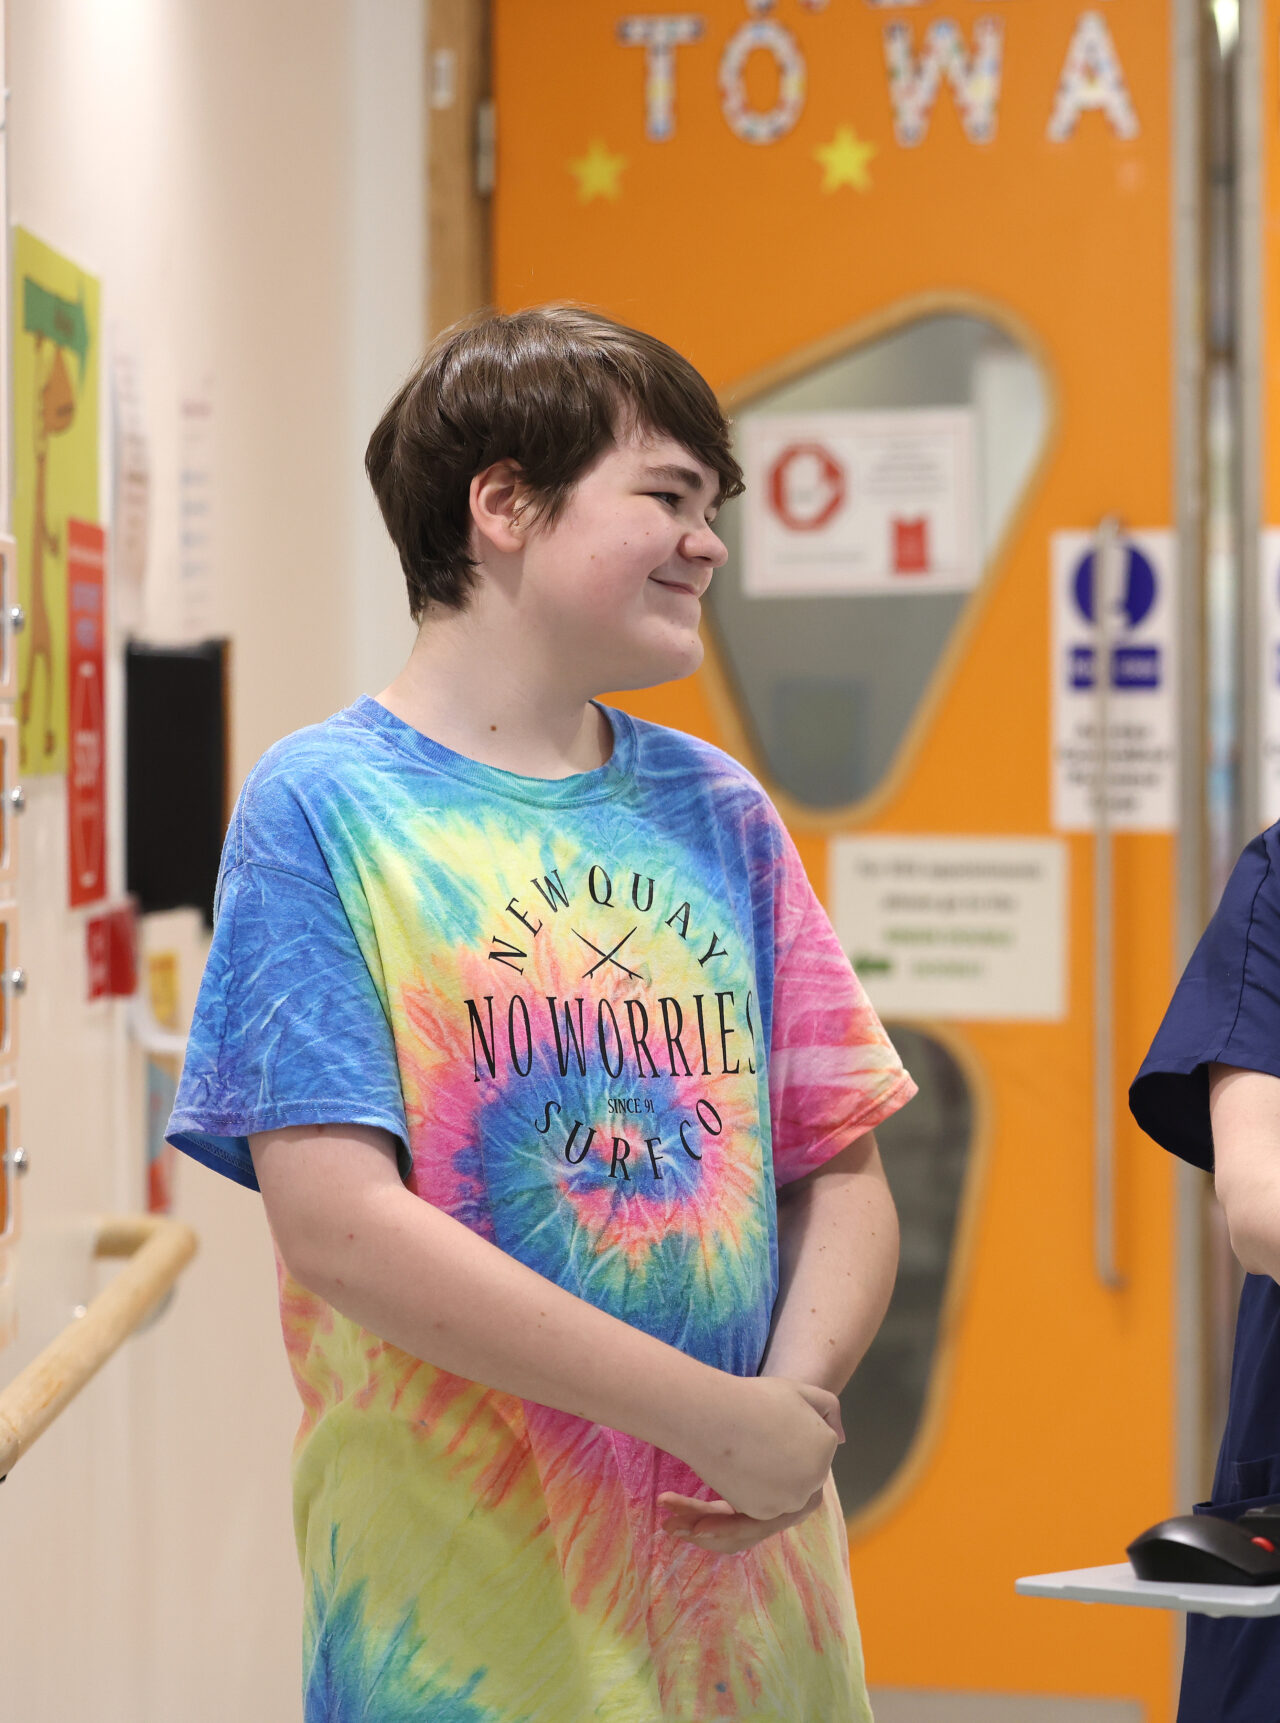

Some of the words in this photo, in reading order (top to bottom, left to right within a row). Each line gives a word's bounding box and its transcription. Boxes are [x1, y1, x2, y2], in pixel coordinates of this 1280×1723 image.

[616, 12, 807, 146] TO
[488, 864, 728, 976] NEWQUAY
[463, 994, 534, 1083] NO
[607, 1098, 642, 1114] SINCE
[644, 1098, 655, 1114] 91
